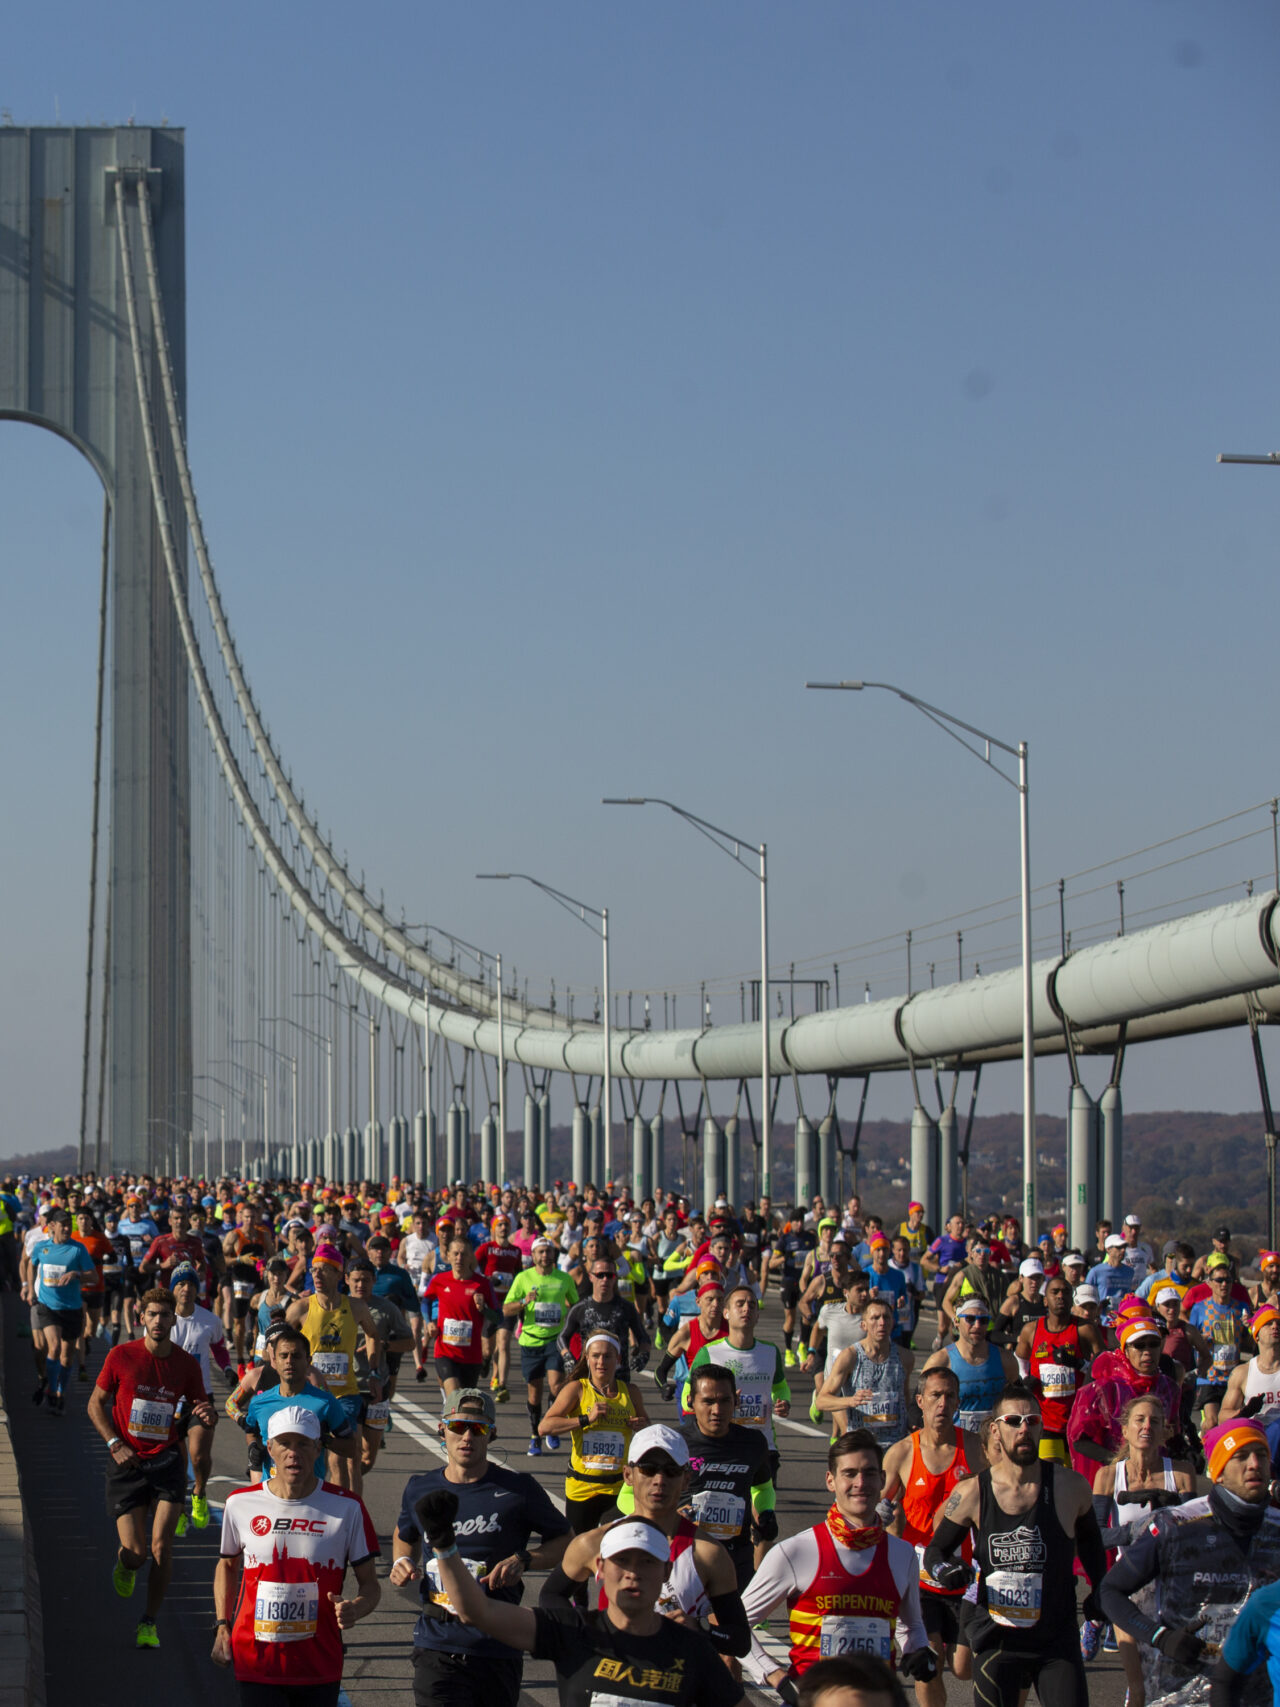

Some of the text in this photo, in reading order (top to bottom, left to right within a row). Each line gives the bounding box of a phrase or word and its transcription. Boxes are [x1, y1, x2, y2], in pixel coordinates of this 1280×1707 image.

[592, 1442, 617, 1457] 5832
[703, 1480, 737, 1491] HUGO
[704, 1506, 731, 1524] 2501
[273, 1518, 327, 1533] BRC
[993, 1545, 1043, 1558] the running
[815, 1593, 896, 1616] SERPENTINE
[998, 1589, 1030, 1607] 5023
[267, 1601, 306, 1621] 13024
